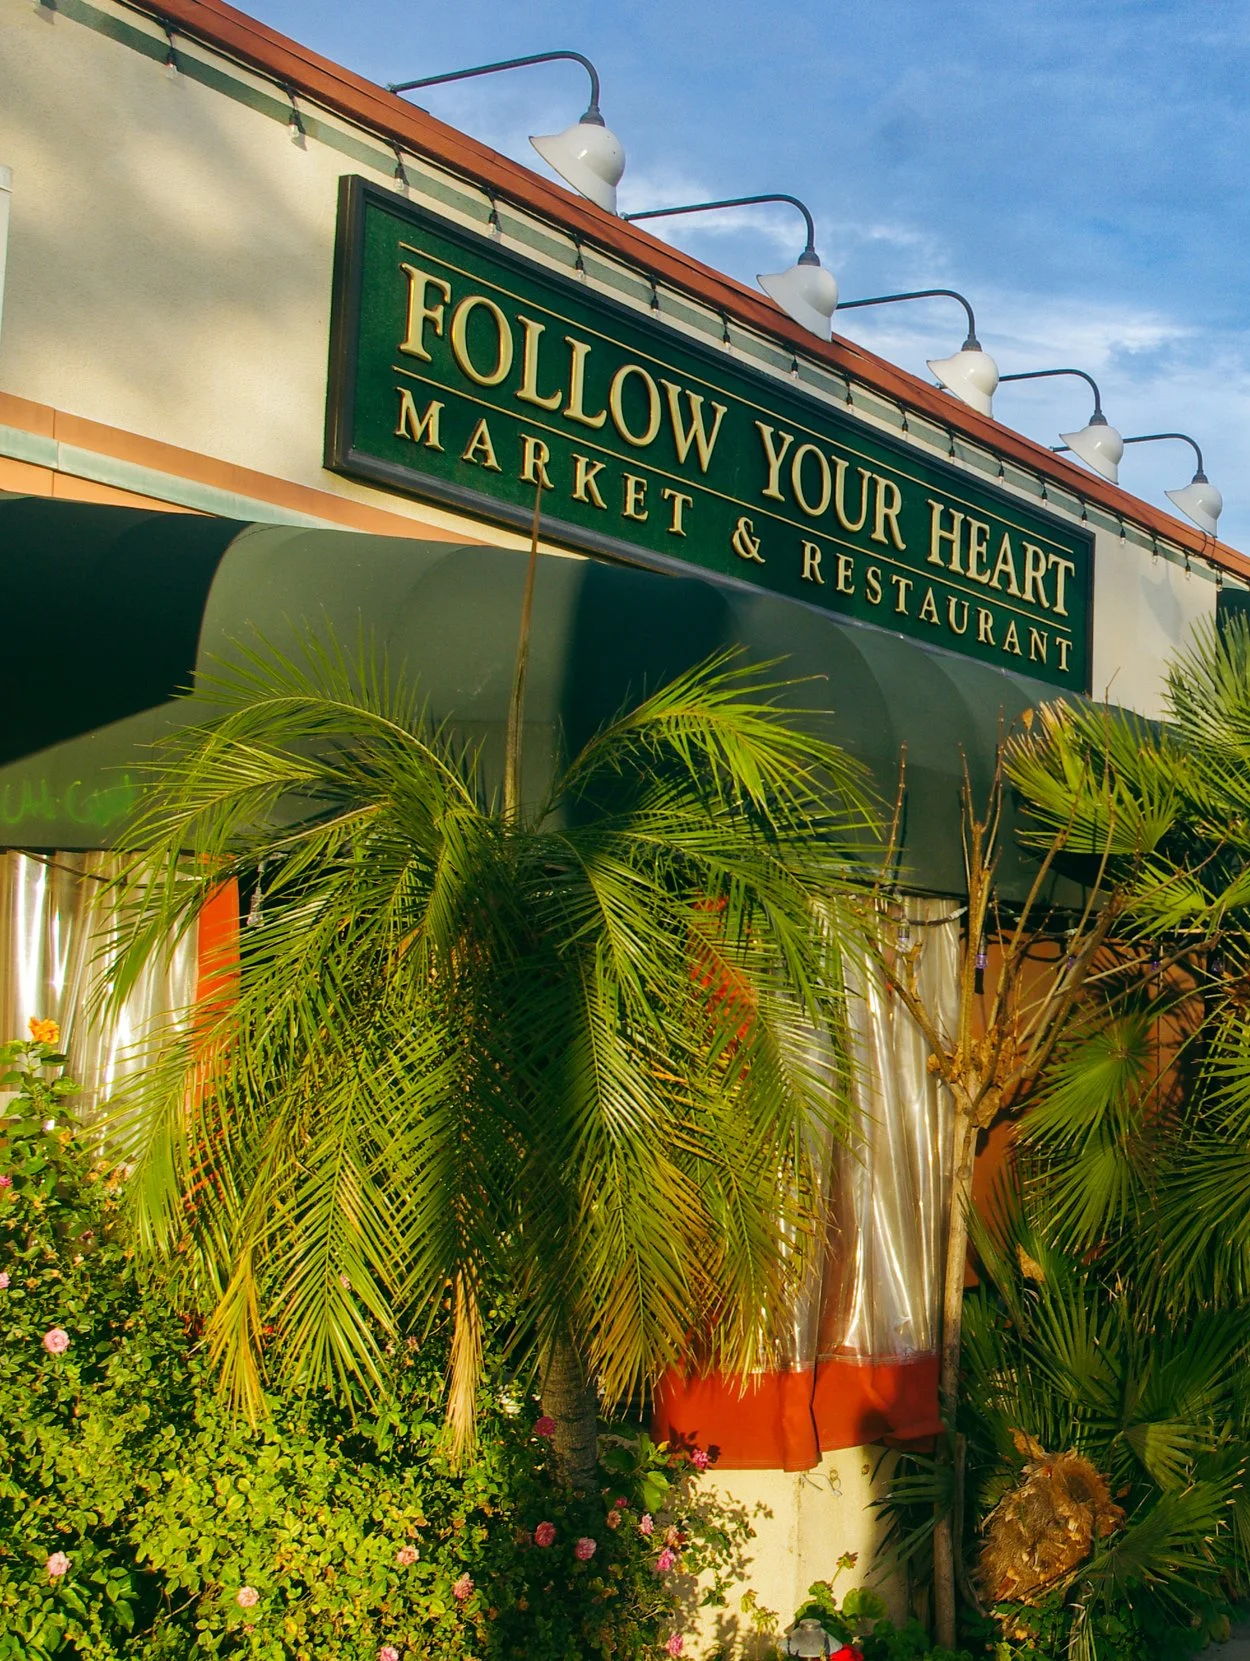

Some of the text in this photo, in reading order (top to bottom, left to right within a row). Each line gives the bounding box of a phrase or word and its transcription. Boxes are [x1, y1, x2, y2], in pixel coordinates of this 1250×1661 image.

[394, 386, 1074, 672] MARKET & RESTAURANT
[399, 261, 1076, 617] FOLLOW YOUR HEART
